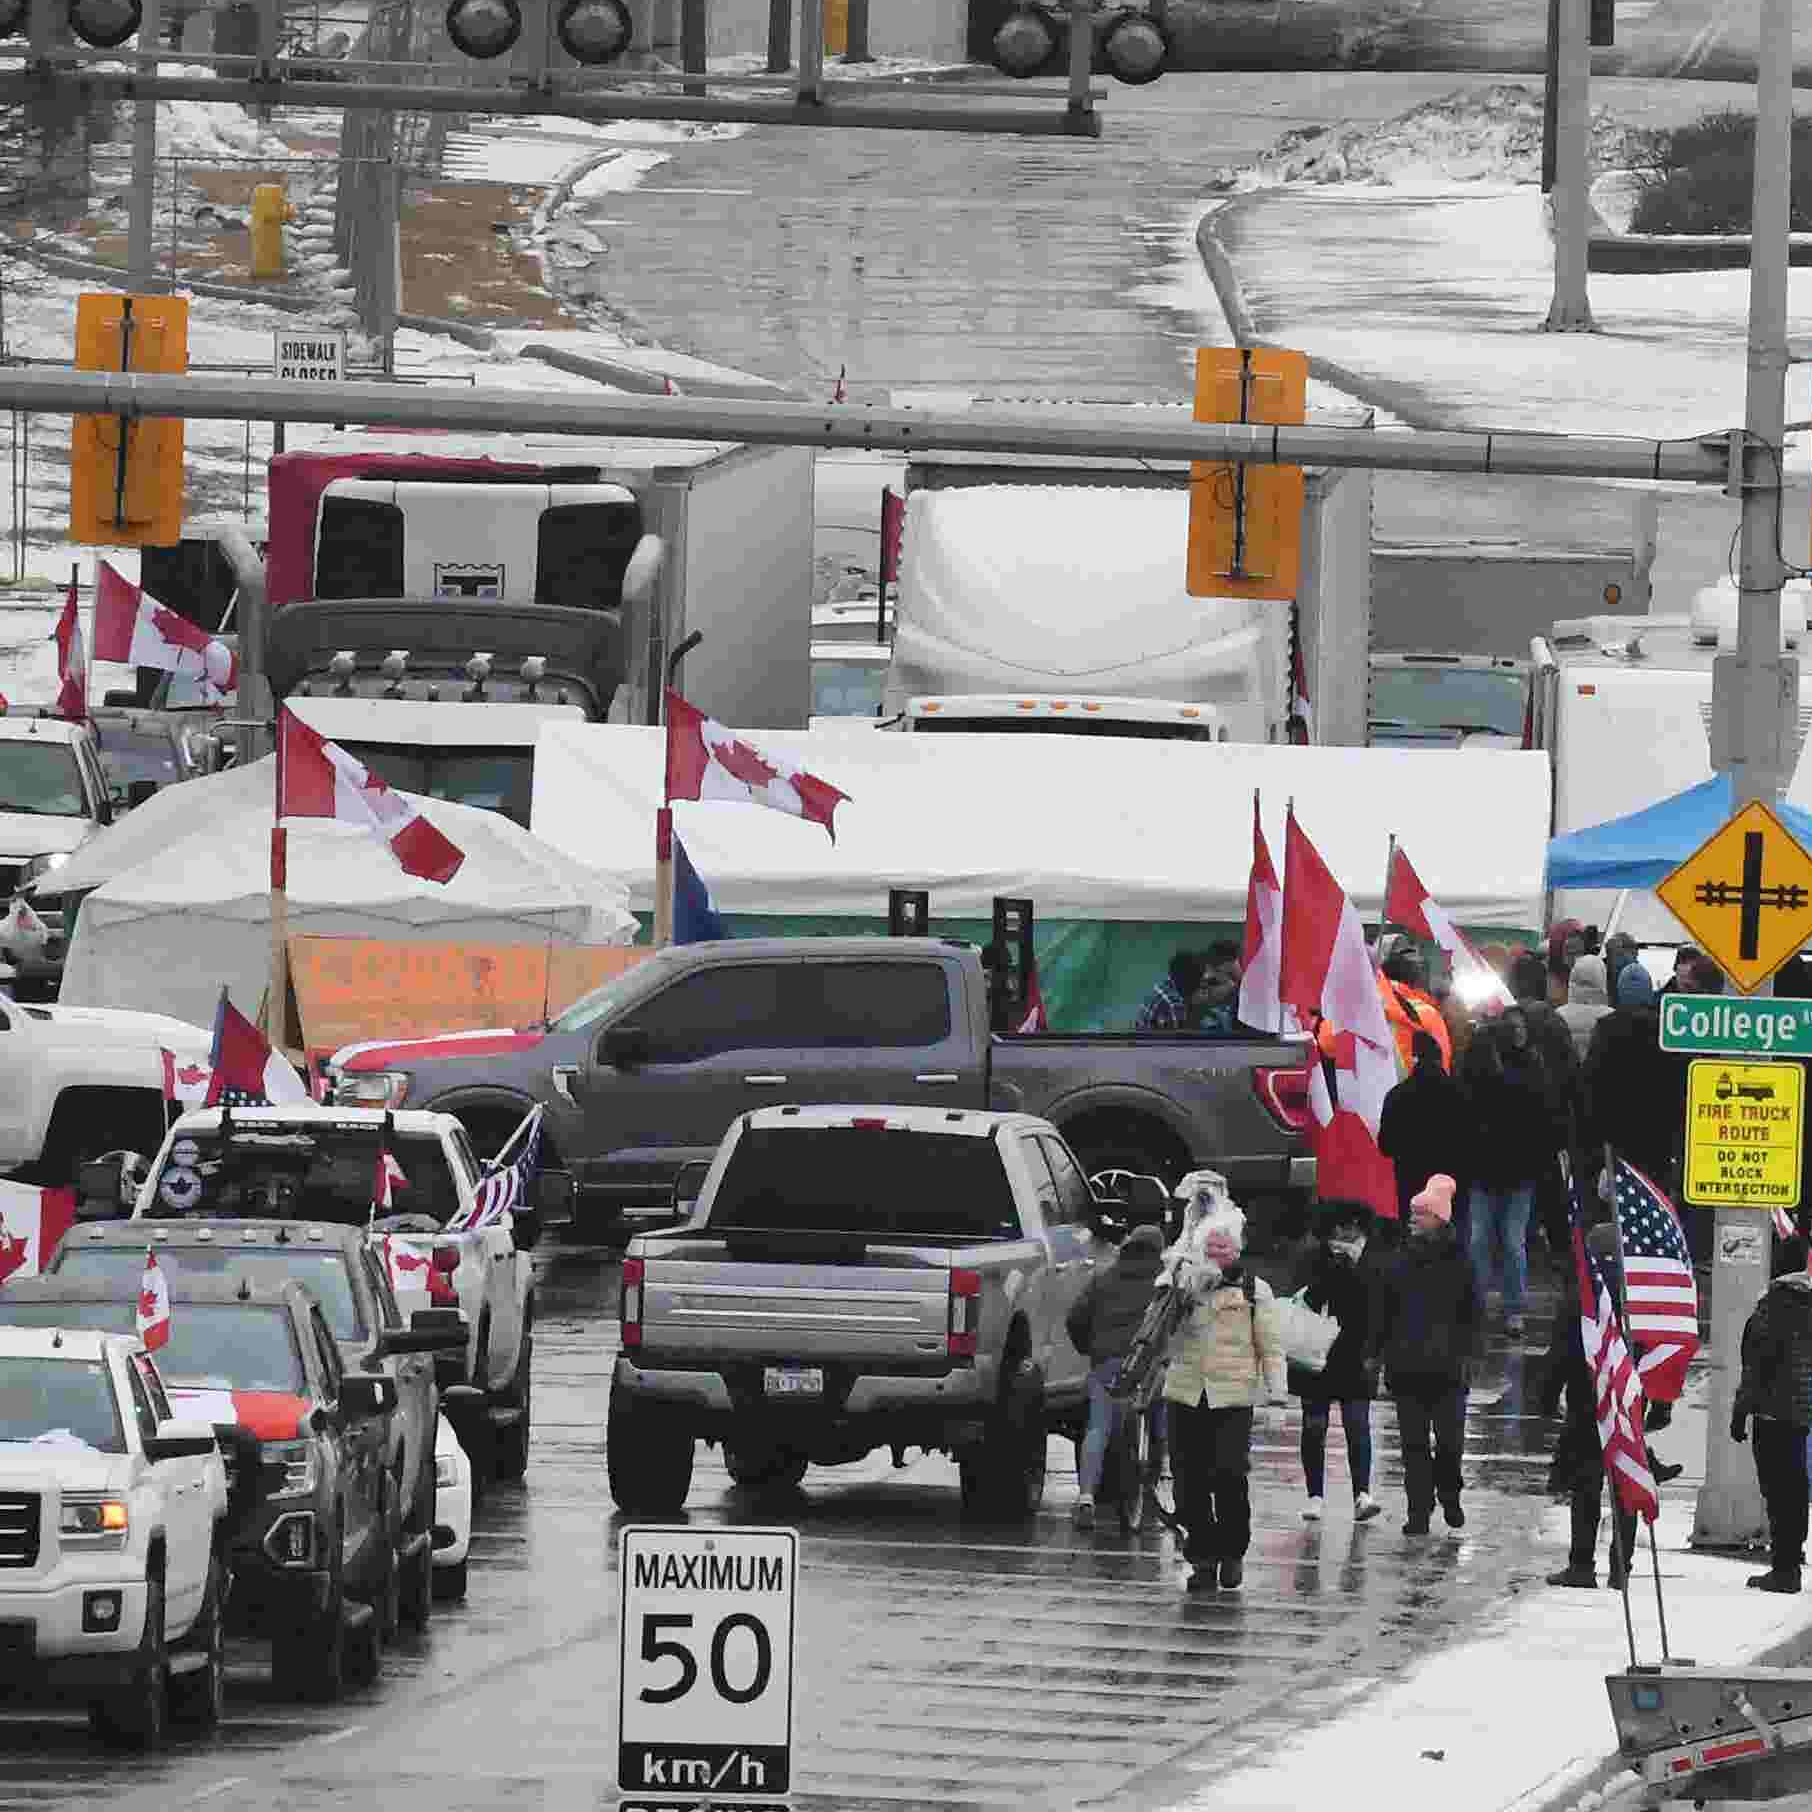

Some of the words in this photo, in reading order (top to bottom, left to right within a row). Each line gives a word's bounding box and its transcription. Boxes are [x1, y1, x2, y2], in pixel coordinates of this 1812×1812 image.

[281, 341, 337, 361] SIDEWALK
[1665, 1002, 1797, 1049] College
[1697, 1104, 1732, 1119] FIRE
[1740, 1105, 1792, 1122] TRUCK
[1718, 1124, 1770, 1141] ROUTE
[1717, 1150, 1737, 1163] DO
[1742, 1151, 1769, 1164] NOT
[1719, 1166, 1764, 1179] BLOCK
[1695, 1181, 1790, 1197] INTERSECTION
[634, 1552, 785, 1592] MAXIMUM
[639, 1612, 772, 1704] 50
[643, 1750, 766, 1788] km/h
